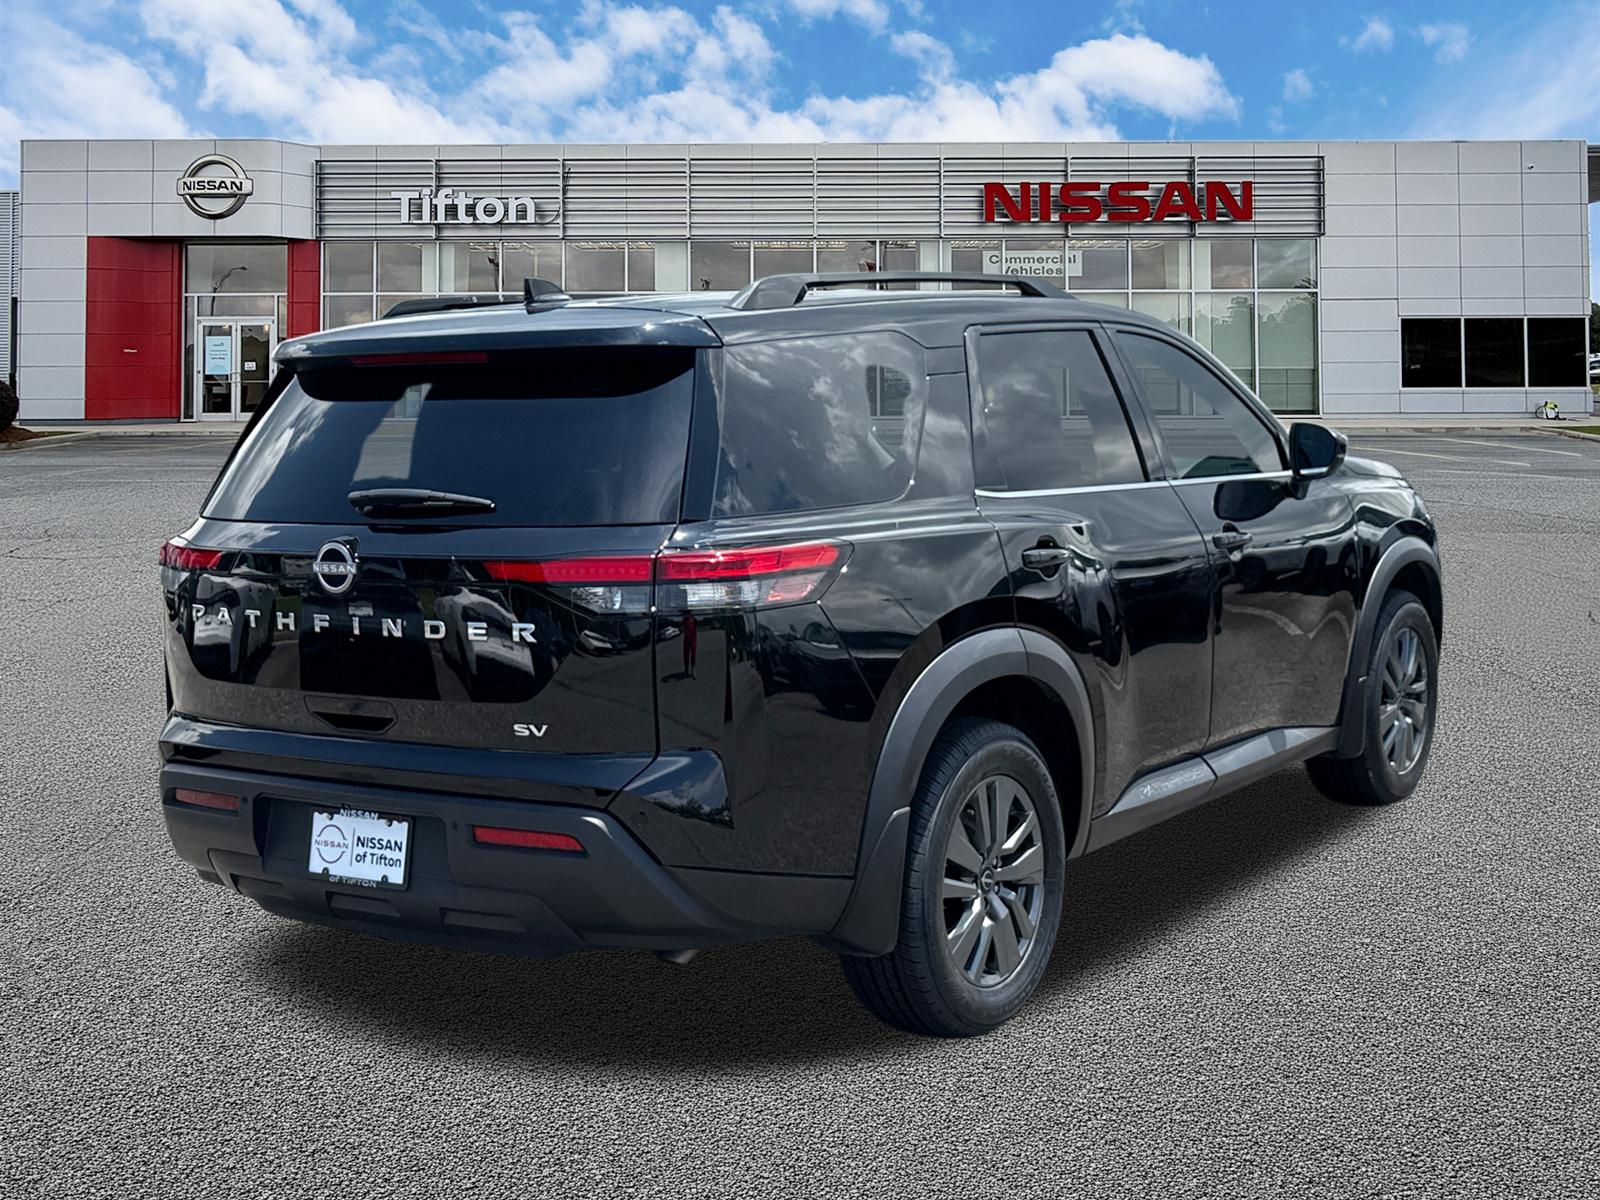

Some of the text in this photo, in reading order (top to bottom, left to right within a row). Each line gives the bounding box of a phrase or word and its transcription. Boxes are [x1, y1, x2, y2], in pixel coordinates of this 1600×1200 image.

[183, 181, 242, 191] NISSAN
[391, 188, 535, 224] Tifton
[984, 181, 1253, 222] NISSAN
[313, 563, 356, 573] NISSAN
[192, 604, 537, 643] PATHFINDER
[513, 723, 548, 736] SV
[340, 809, 378, 820] NISSAN
[315, 839, 349, 849] NISSAN
[356, 836, 402, 852] NISSAN
[355, 852, 402, 868] of Tifton
